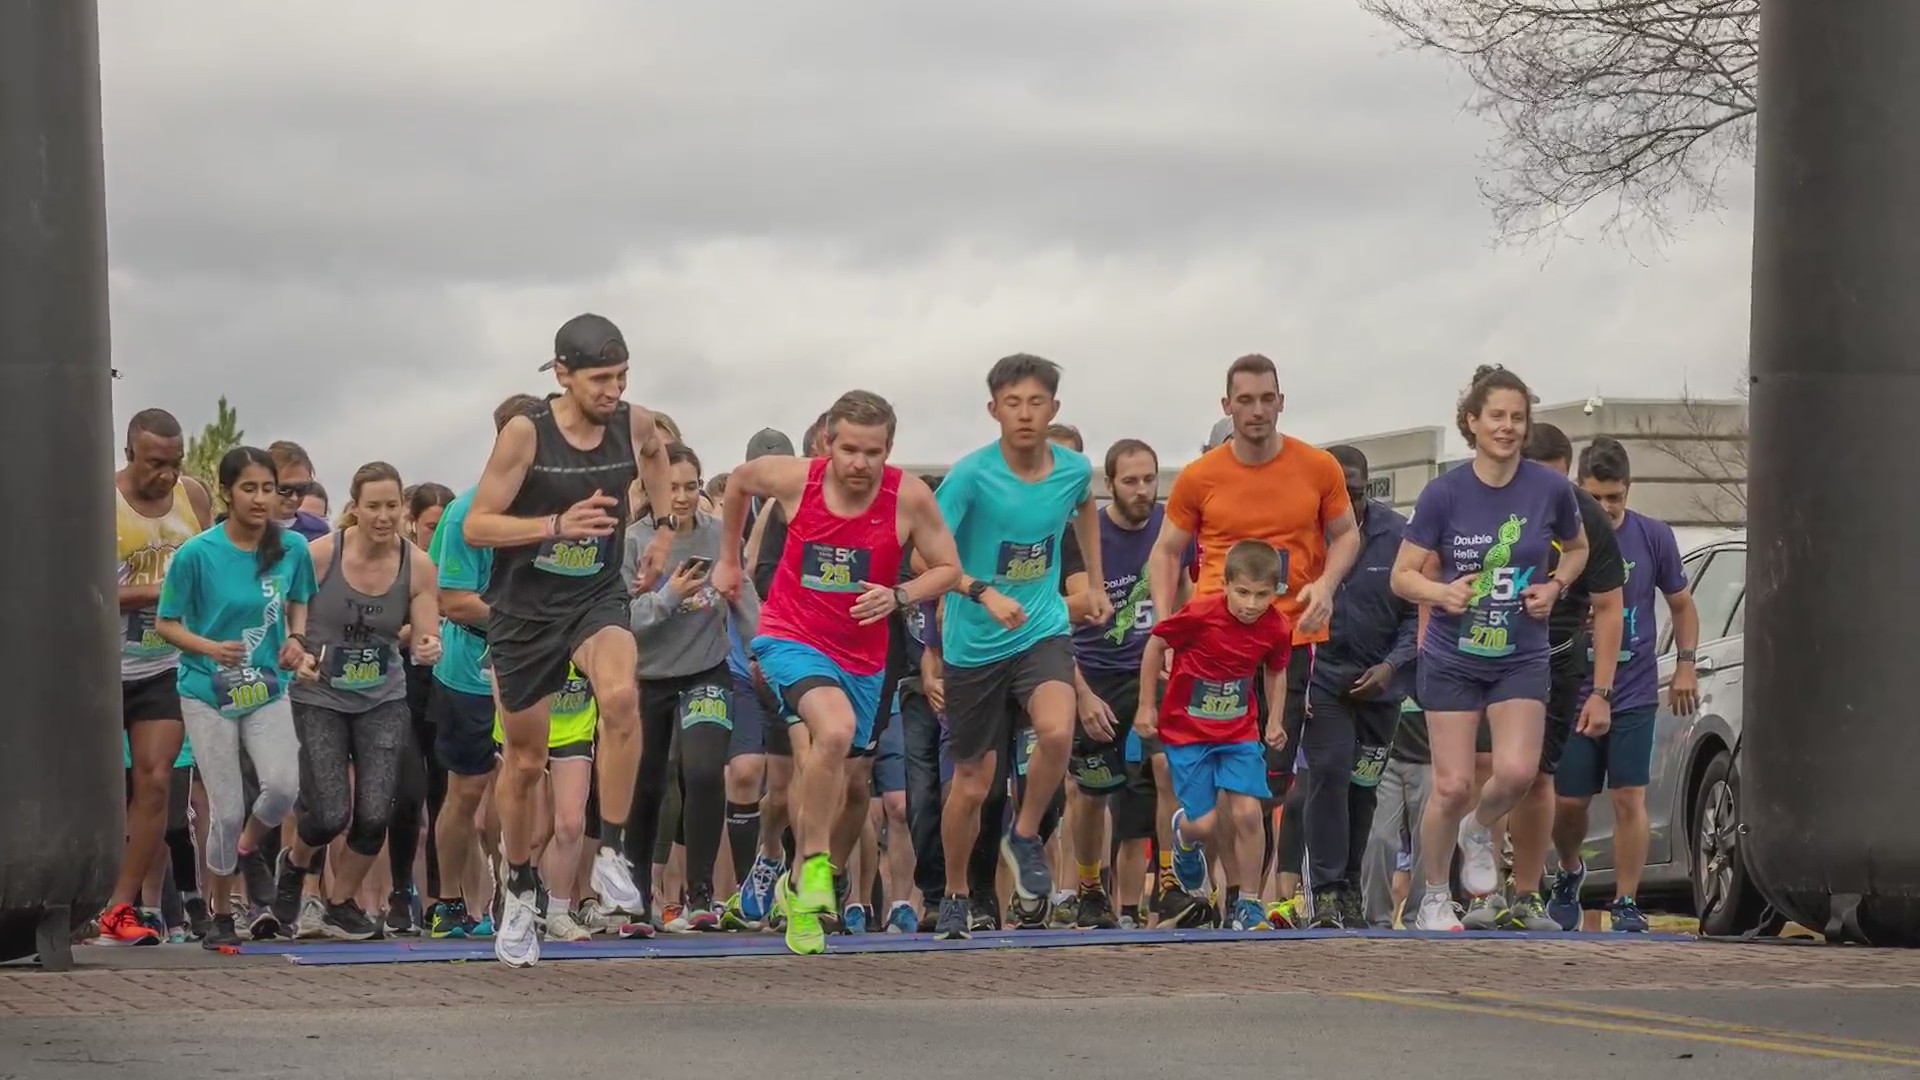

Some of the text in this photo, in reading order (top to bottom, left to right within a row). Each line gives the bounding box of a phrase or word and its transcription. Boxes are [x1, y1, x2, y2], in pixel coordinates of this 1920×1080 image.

[1453, 534, 1494, 546] Double
[834, 548, 858, 563] 5K
[1453, 549, 1480, 560] Helix
[820, 562, 850, 587] 25
[1491, 566, 1537, 600] 5K
[1489, 610, 1509, 626] 5K
[362, 647, 380, 662] 5K
[242, 667, 264, 682] 5K
[706, 685, 726, 700] 5K
[1223, 680, 1242, 695] 5K
[228, 682, 269, 710] 100
